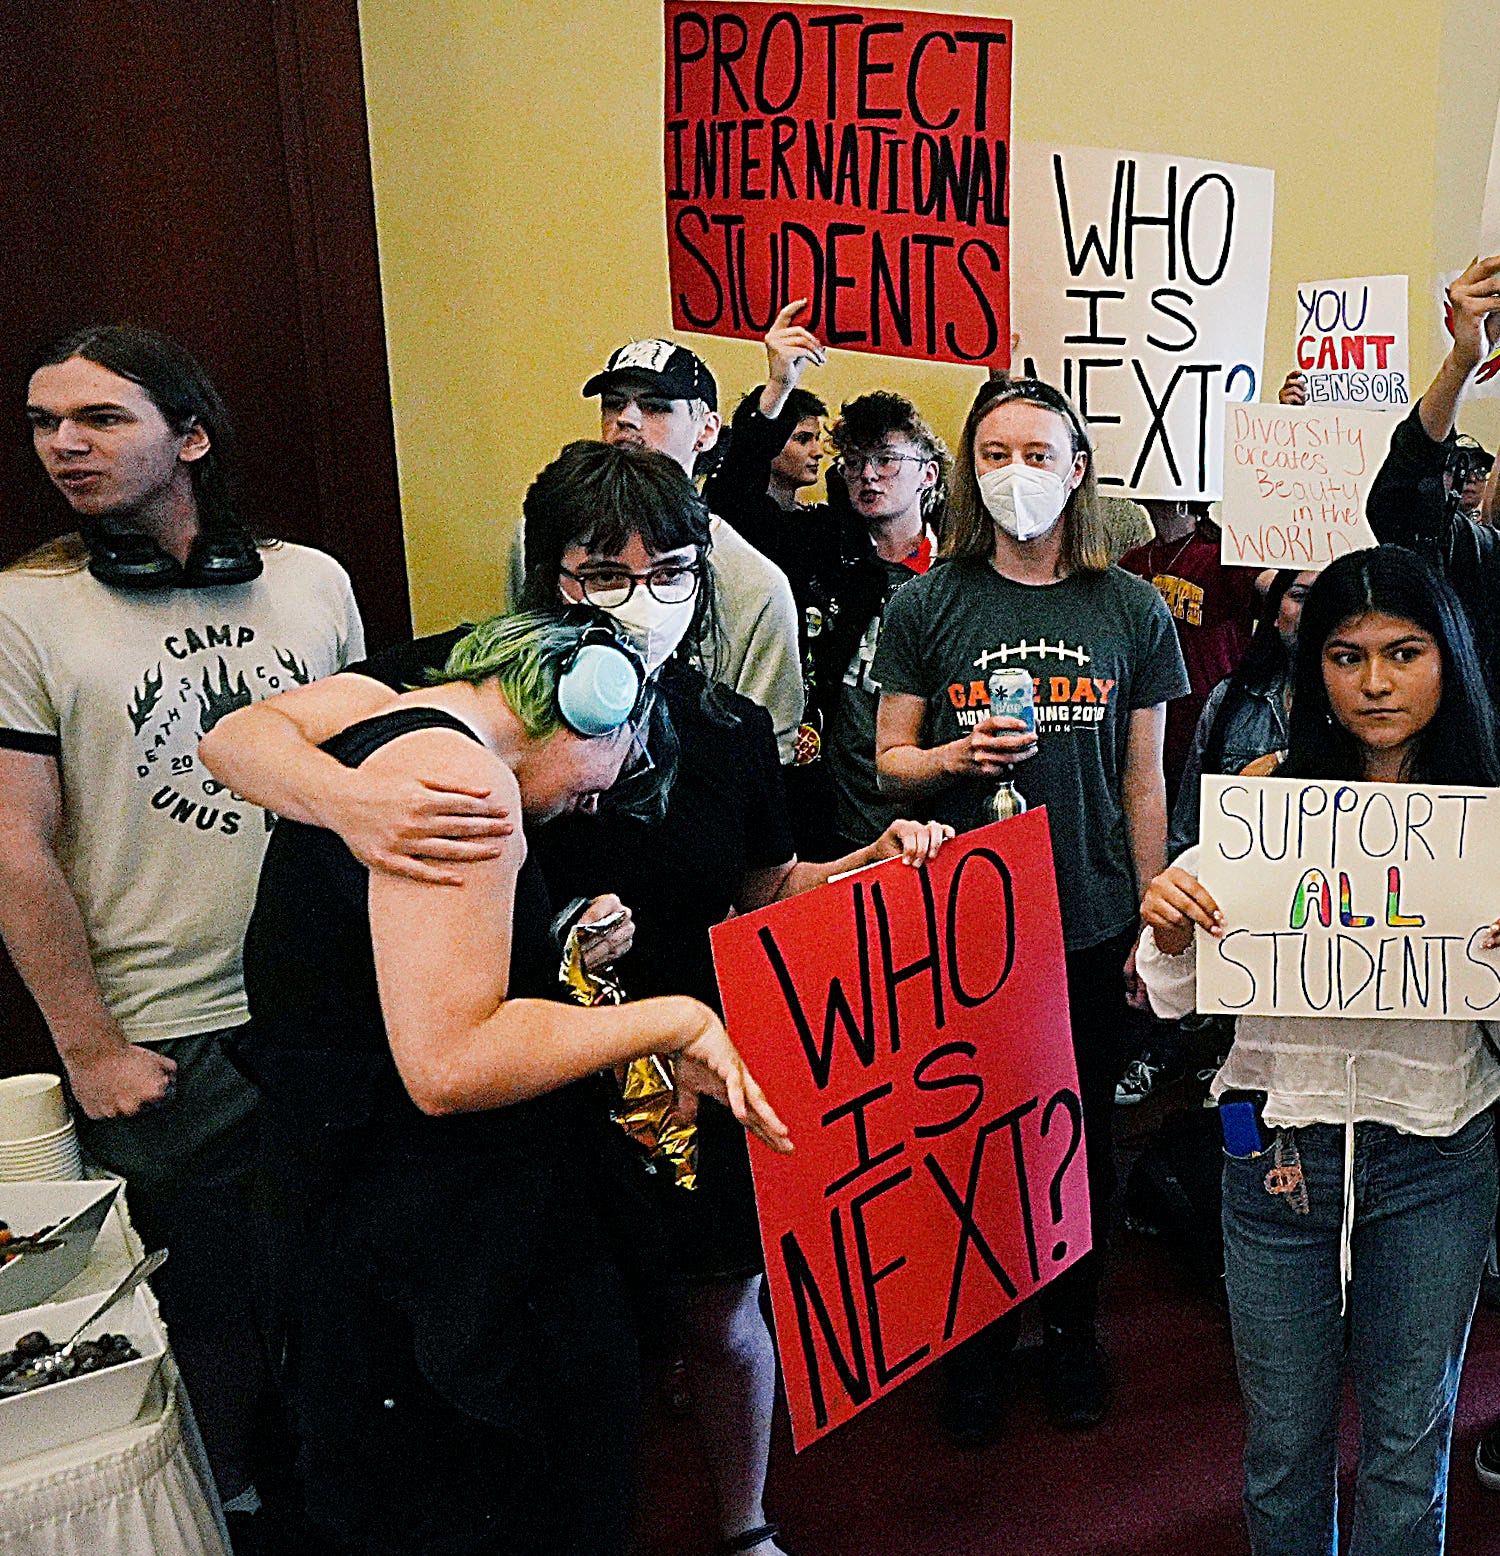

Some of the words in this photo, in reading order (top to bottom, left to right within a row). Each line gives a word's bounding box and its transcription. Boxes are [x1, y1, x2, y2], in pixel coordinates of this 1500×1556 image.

[672, 11, 1007, 131] PROTECT
[667, 115, 1010, 227] INTERNATIONAL
[1053, 153, 1236, 286] WHO
[674, 205, 1001, 361] STUDENTS
[1298, 286, 1368, 335] YOU
[1064, 288, 1198, 352] IS
[1297, 335, 1395, 370] CANT
[1233, 408, 1366, 476] Diversity
[1256, 468, 1359, 508] Beauty
[1293, 504, 1314, 523] in
[1321, 503, 1359, 526] the
[165, 624, 255, 659] CAMP
[948, 676, 1041, 709] GAE
[1049, 676, 1116, 704] DAY
[150, 784, 242, 835] UNUS
[1218, 785, 1488, 869] SUPPORT
[1289, 866, 1425, 929] ALL
[758, 847, 1017, 1091] WHO
[821, 1041, 985, 1199] IS
[780, 1088, 1084, 1429] NEXT?
